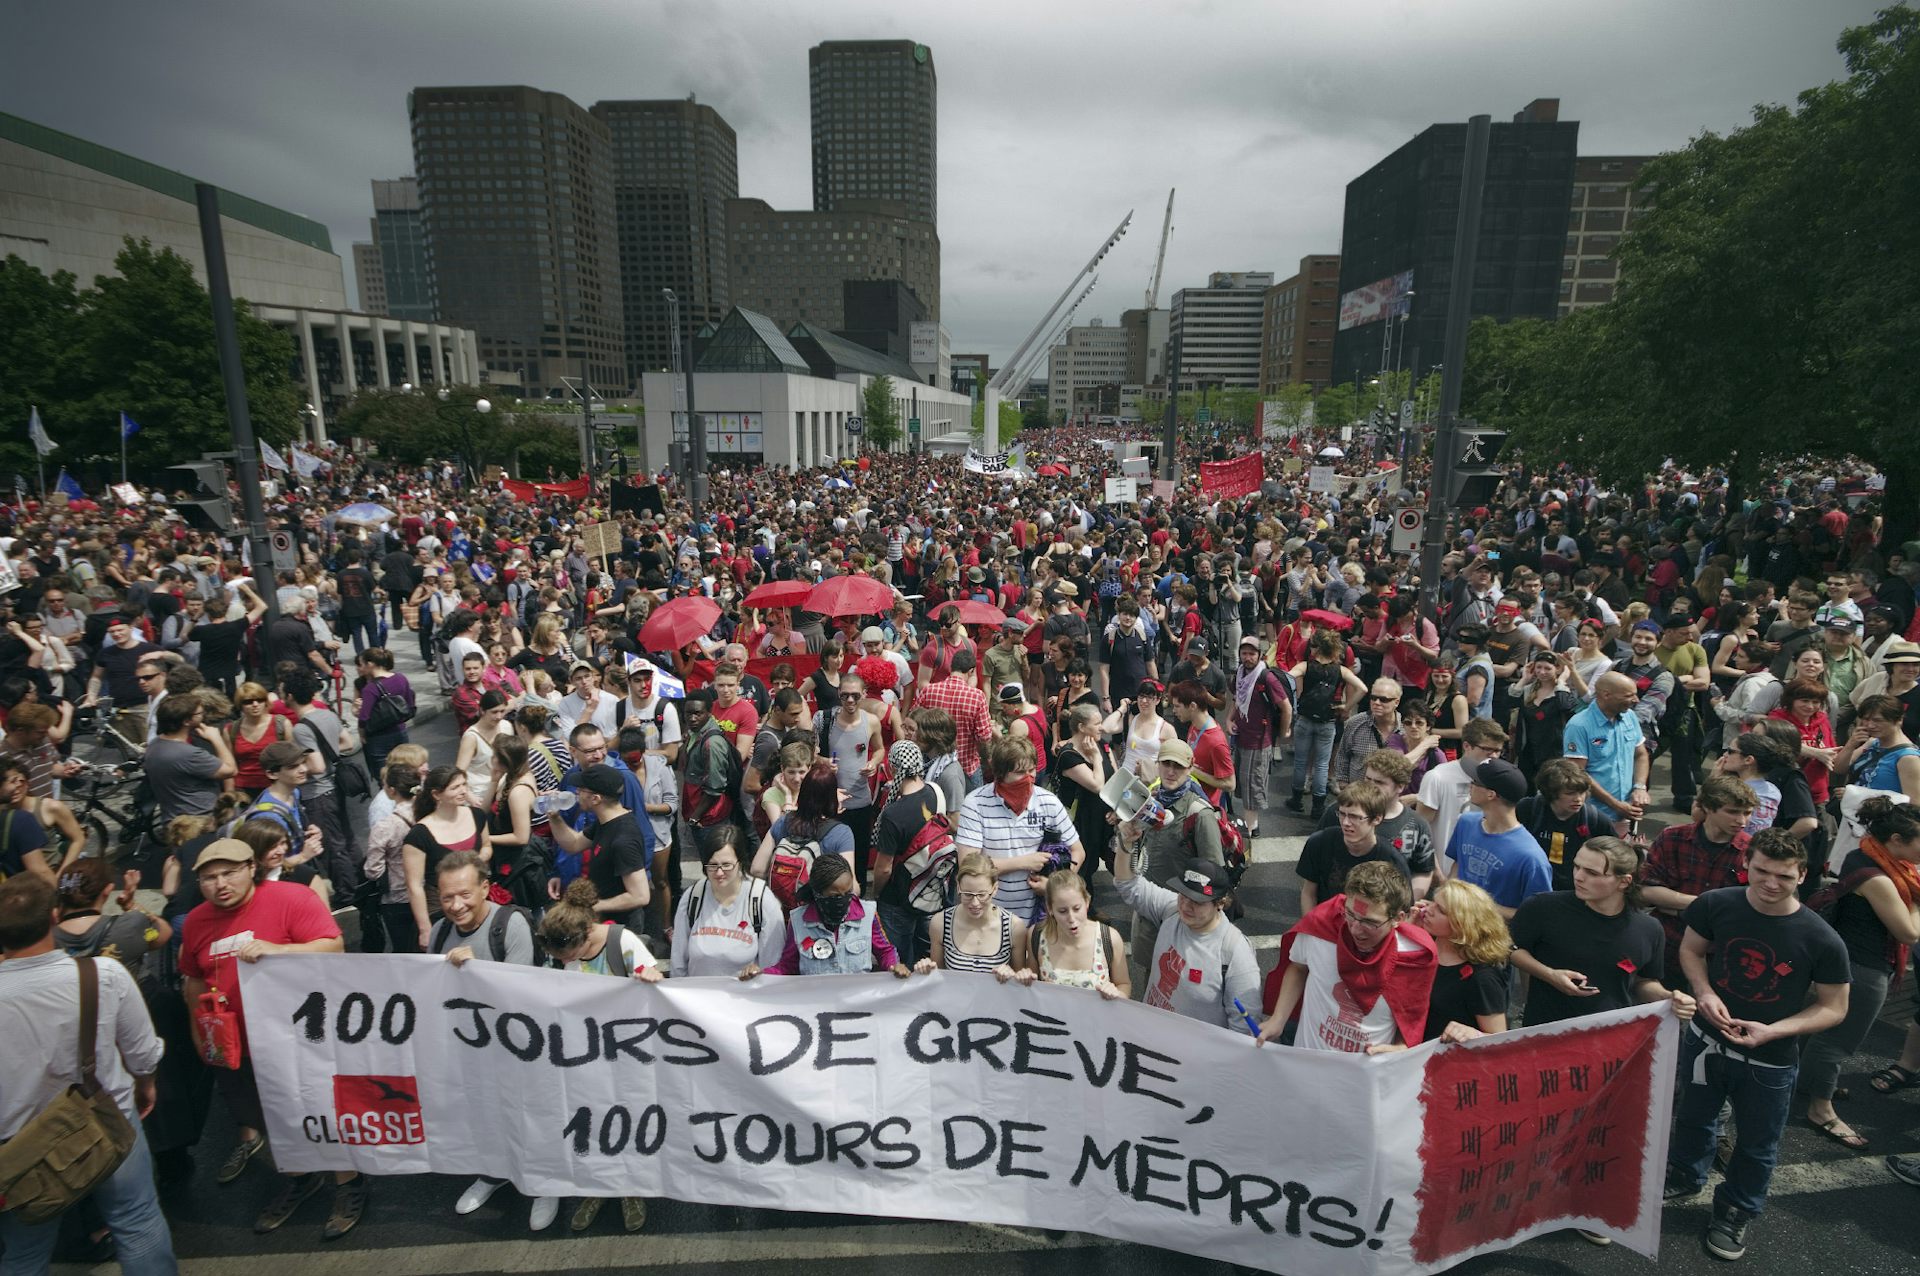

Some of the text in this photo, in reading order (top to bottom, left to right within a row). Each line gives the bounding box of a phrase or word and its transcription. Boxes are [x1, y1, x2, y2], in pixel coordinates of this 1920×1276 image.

[293, 991, 1214, 1125] 100 JOURS DE GRÈVE,
[303, 1111, 422, 1144] CLASSE
[563, 1104, 667, 1156] 100
[689, 1112, 920, 1170] JOURS
[943, 1115, 1050, 1180] DE
